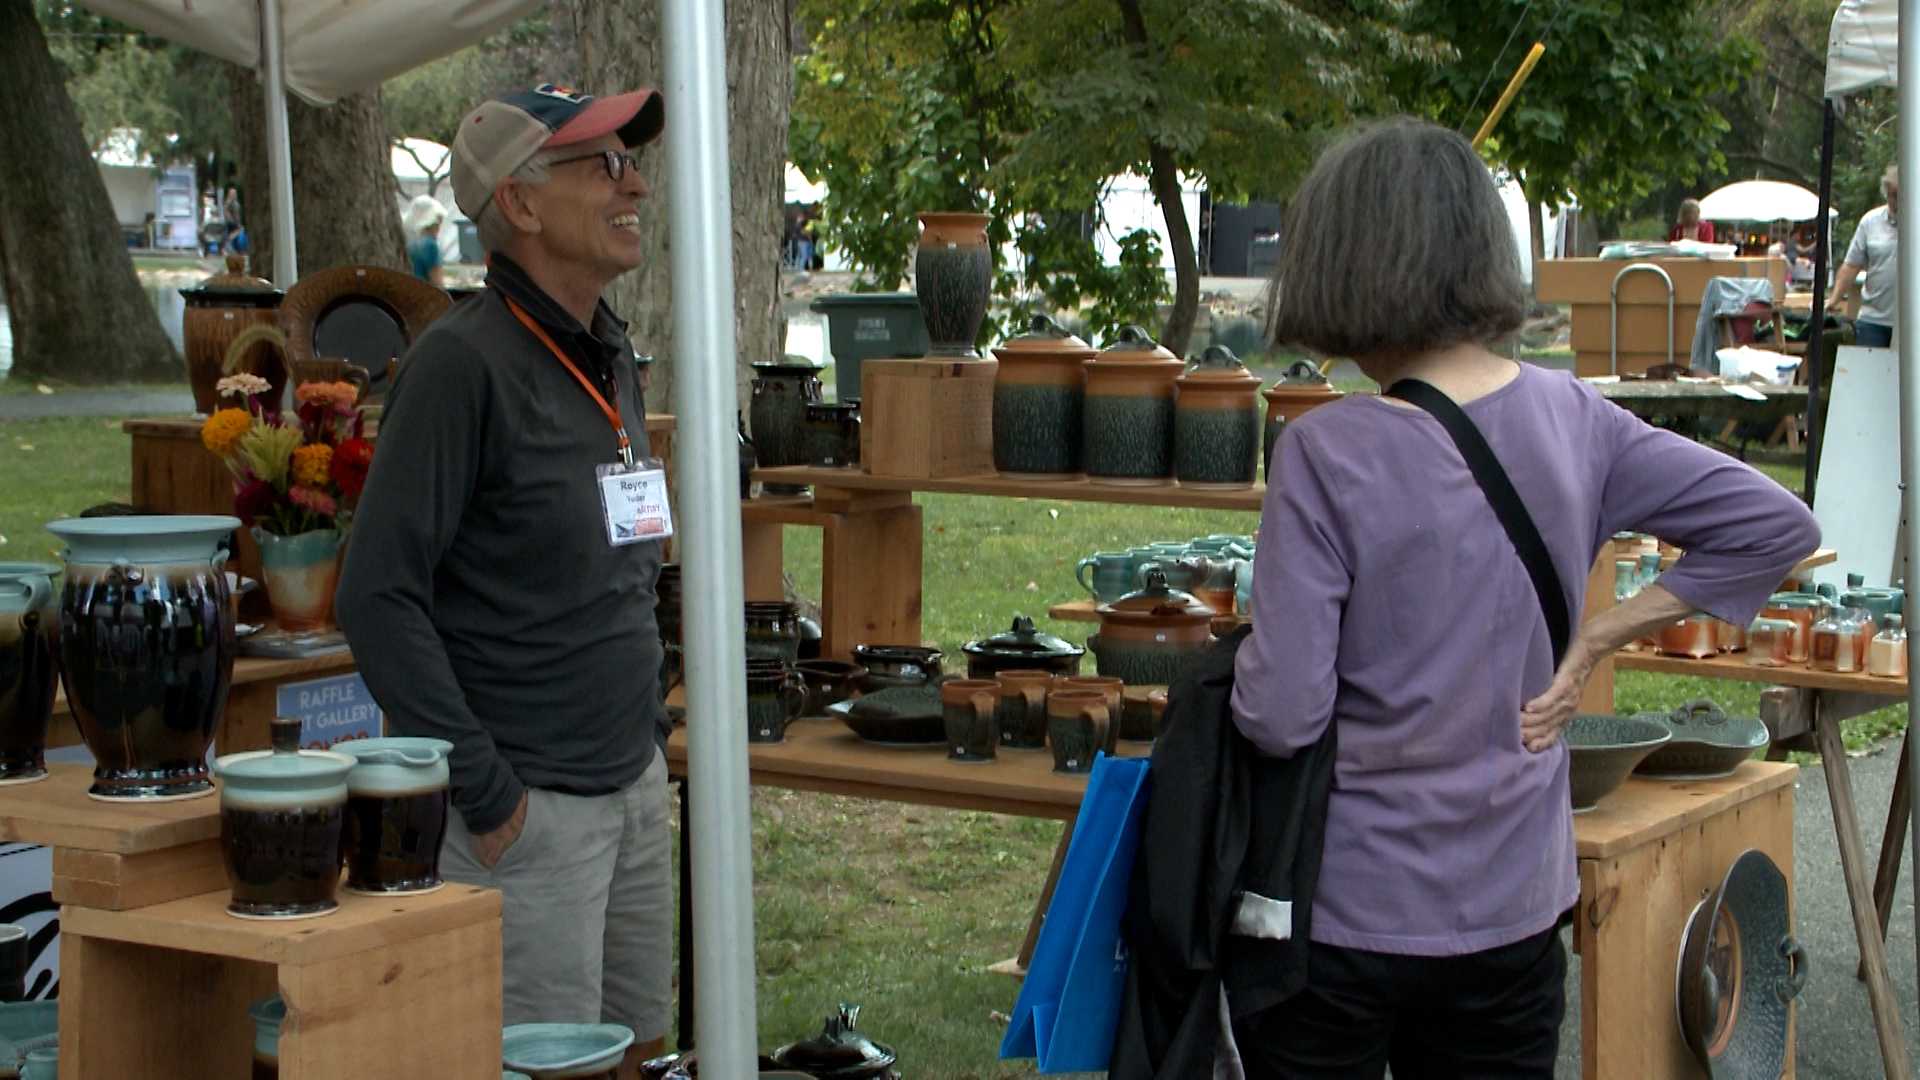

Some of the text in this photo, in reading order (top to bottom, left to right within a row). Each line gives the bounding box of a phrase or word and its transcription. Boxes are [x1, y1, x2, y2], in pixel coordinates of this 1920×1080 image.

[620, 480, 648, 491] Royce
[300, 683, 355, 710] RAFFLE
[316, 703, 376, 729] GALLERY
